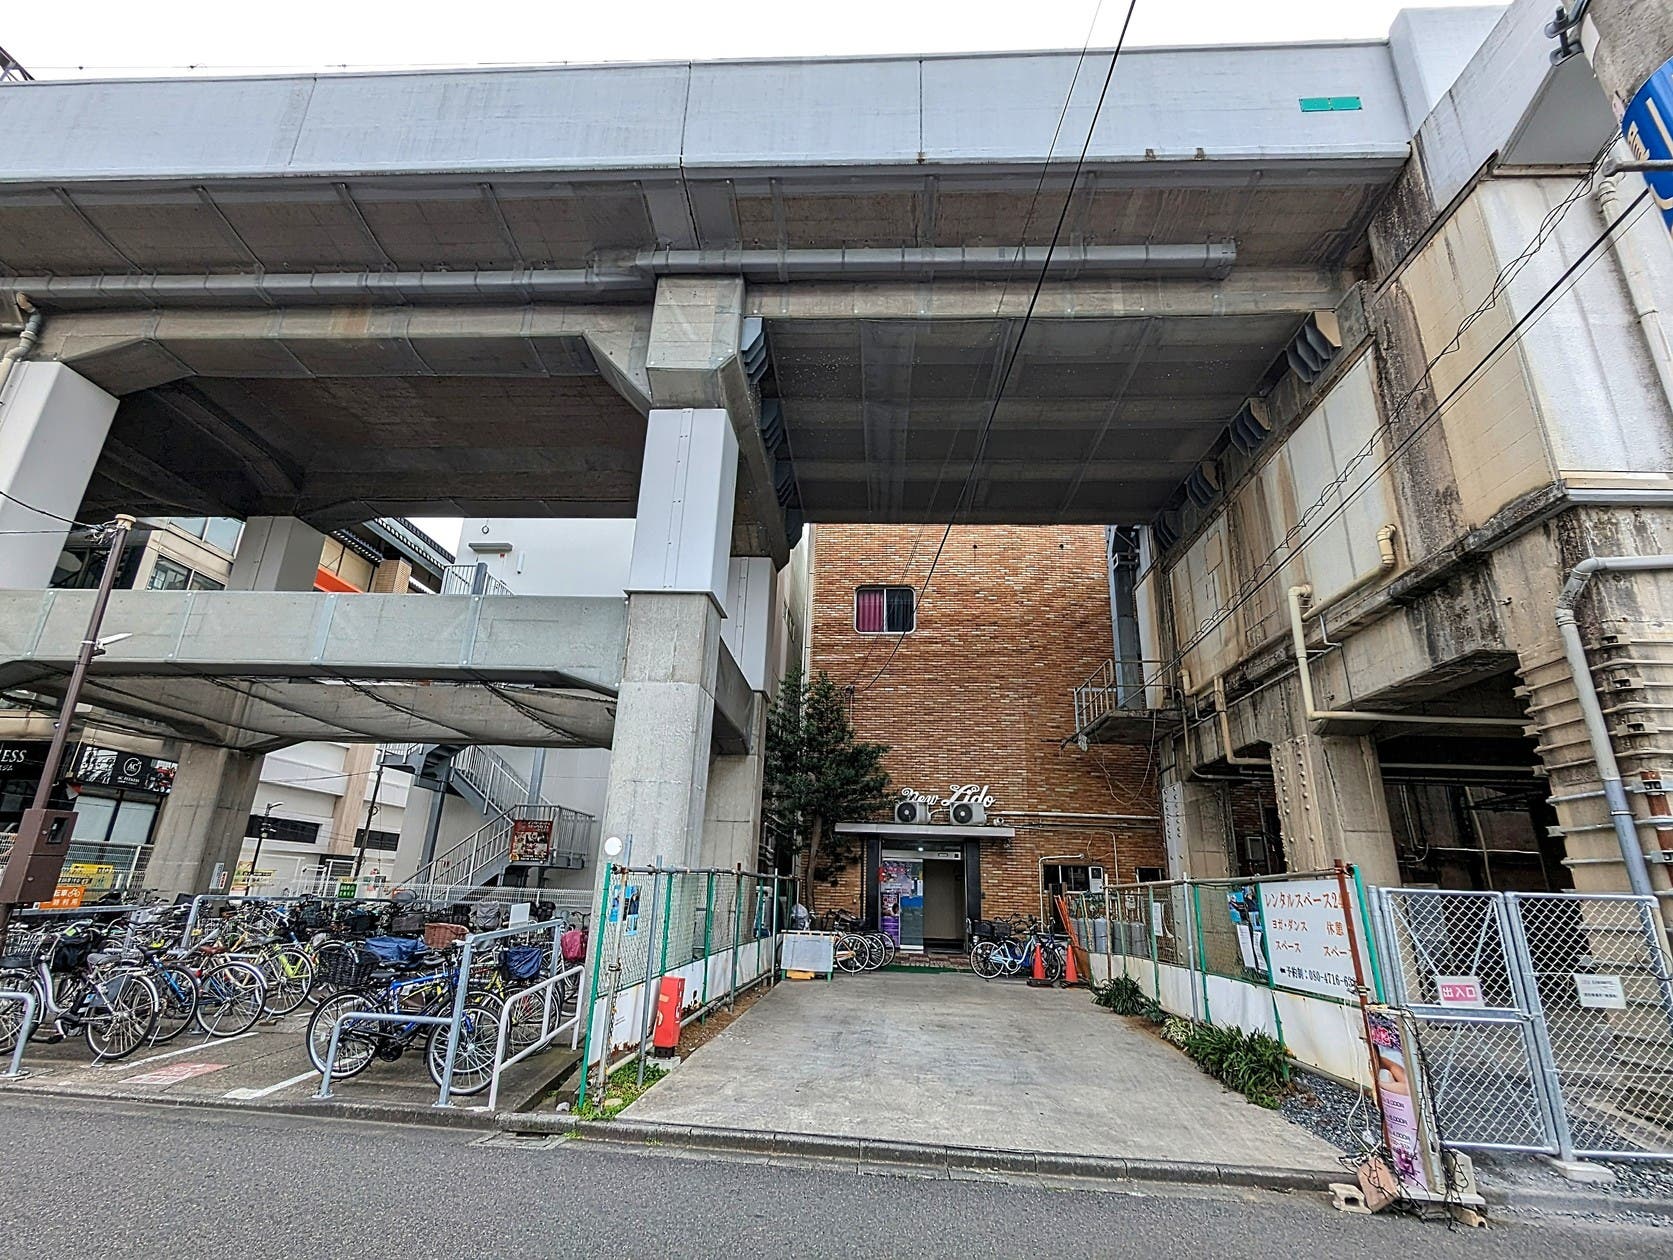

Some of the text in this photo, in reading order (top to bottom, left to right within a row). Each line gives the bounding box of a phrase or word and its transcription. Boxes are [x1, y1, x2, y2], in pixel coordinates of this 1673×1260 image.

[901, 784, 996, 808] New Lido
[1275, 940, 1301, 953] スペース
[1442, 986, 1477, 998] 出入口
